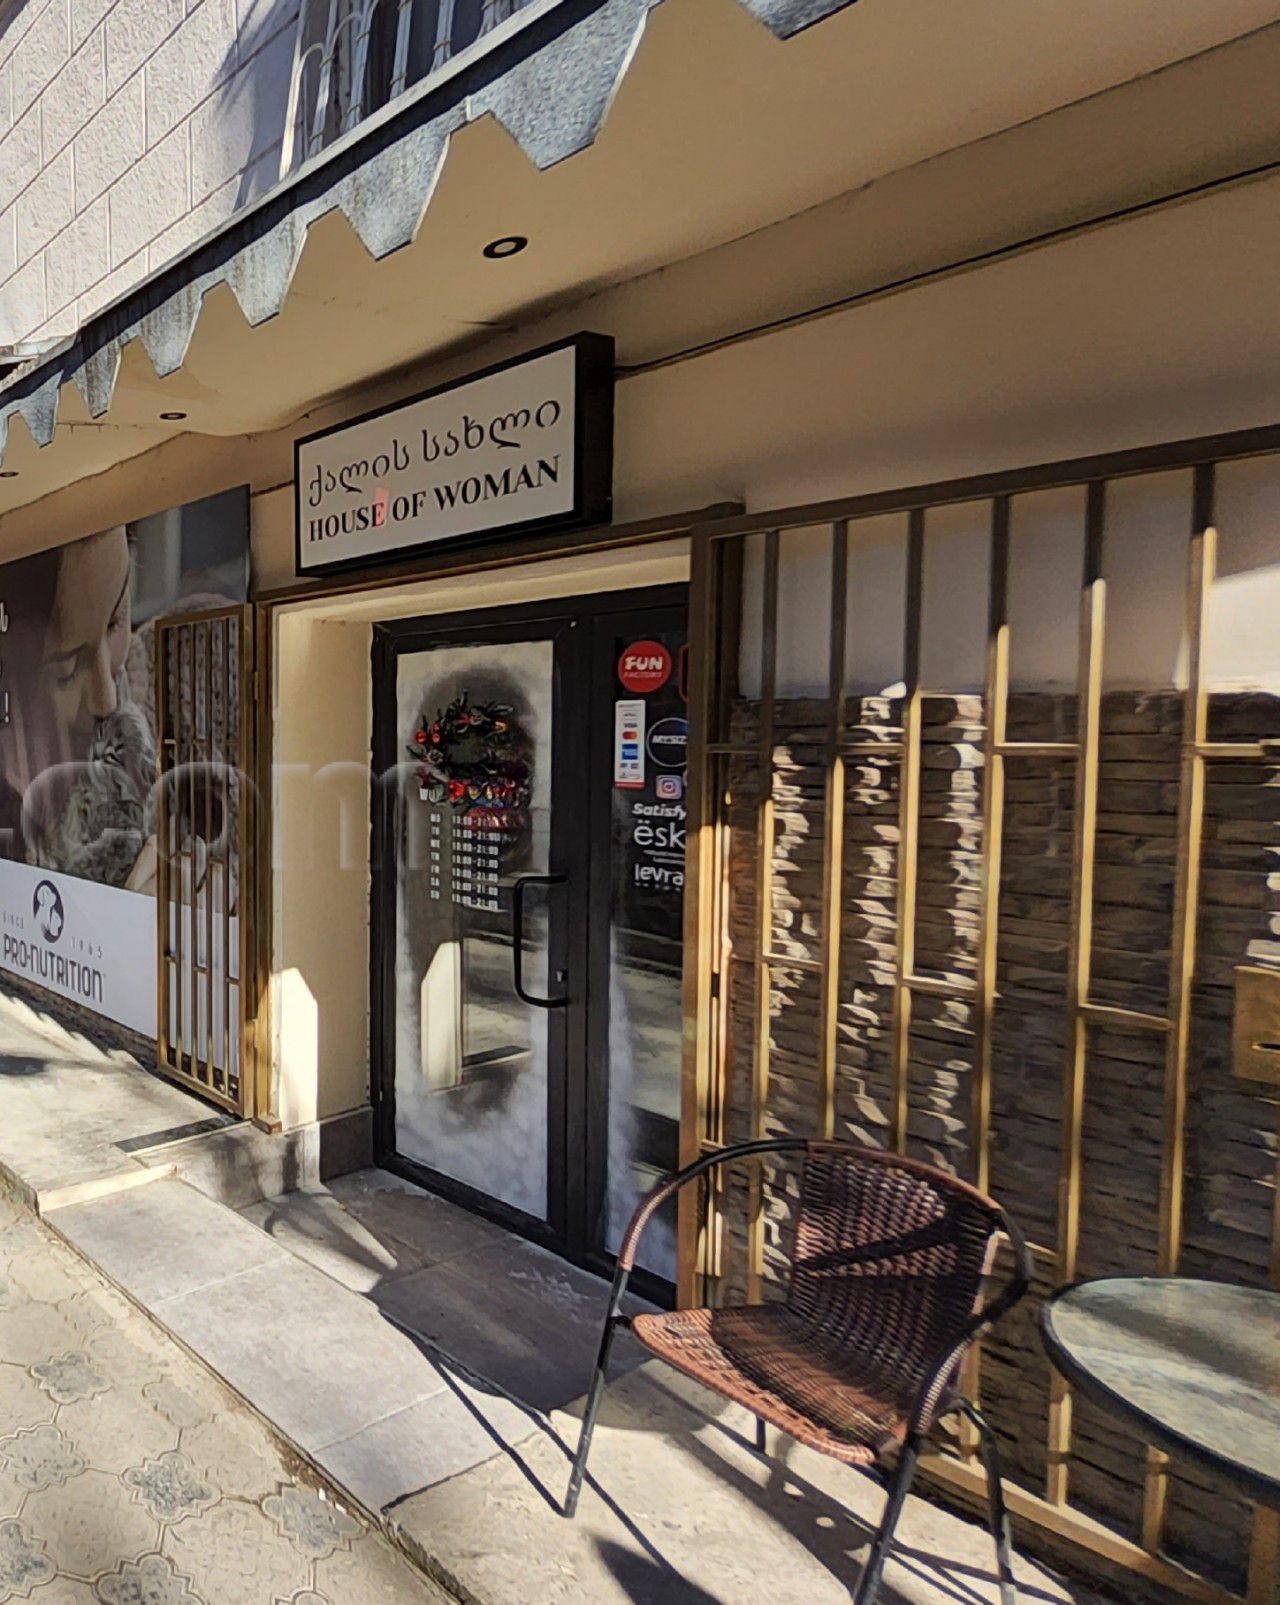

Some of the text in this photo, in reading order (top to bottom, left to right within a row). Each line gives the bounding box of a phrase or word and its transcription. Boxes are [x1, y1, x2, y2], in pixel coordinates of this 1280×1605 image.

[308, 399, 561, 507] ქალის სახლი
[309, 455, 562, 543] HOUSE OF WOMAN
[624, 656, 663, 670] FUN
[3, 933, 103, 1003] PRO-NUTRITION
